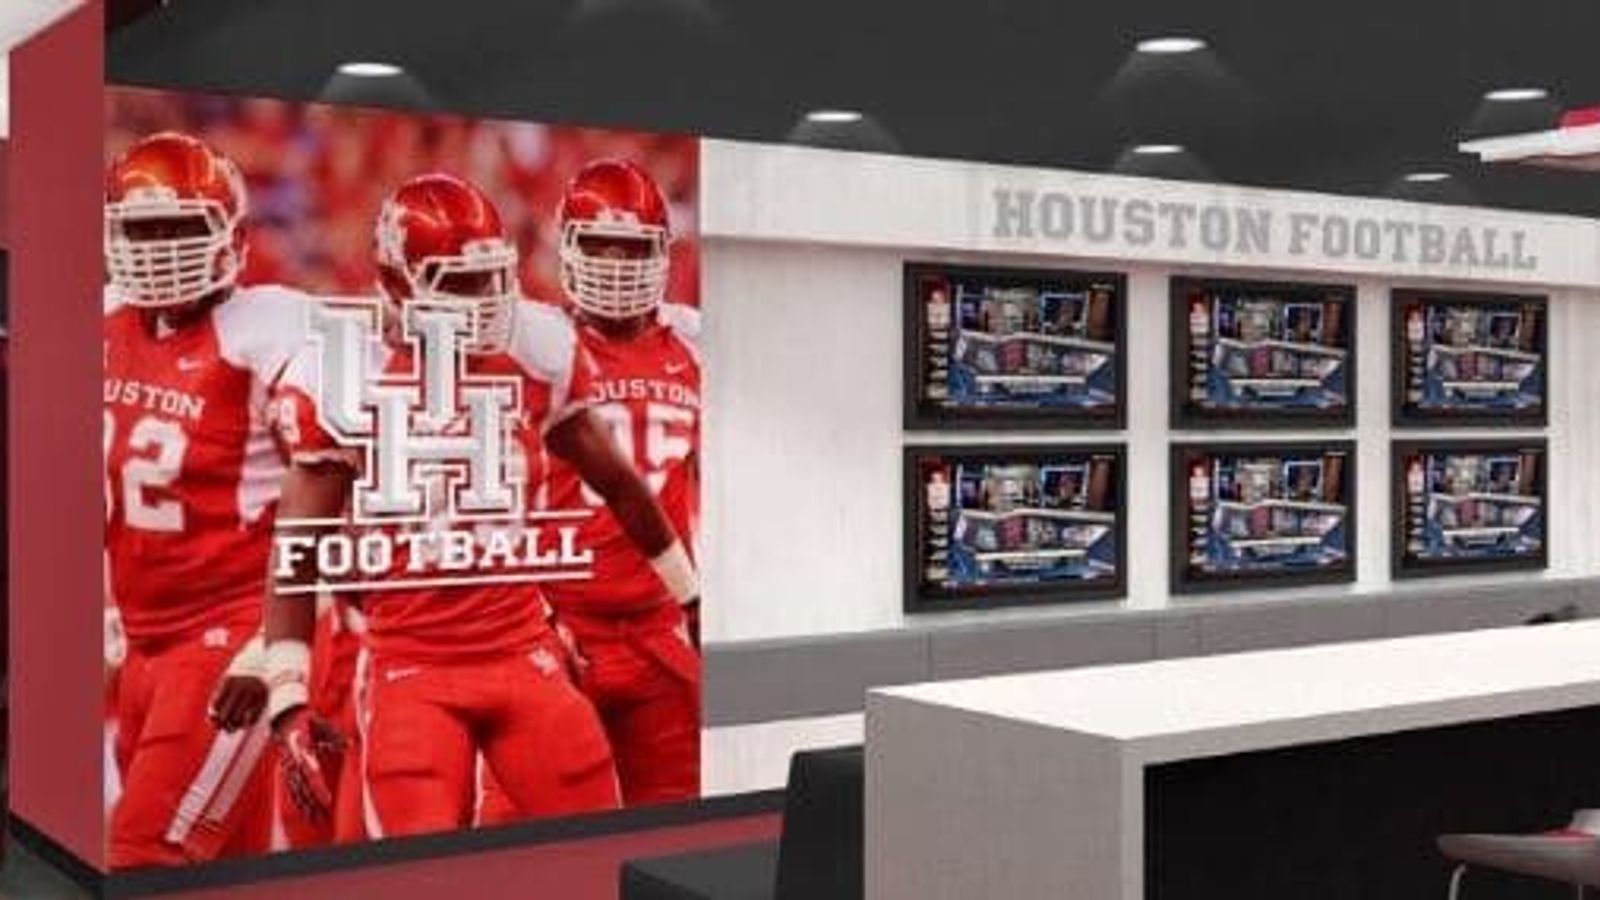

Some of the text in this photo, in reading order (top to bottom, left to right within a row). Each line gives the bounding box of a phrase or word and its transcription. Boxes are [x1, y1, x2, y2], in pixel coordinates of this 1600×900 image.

[992, 189, 1537, 271] HOUSTON FOOTBALL
[305, 297, 524, 525] UH
[273, 527, 595, 578] FOOTBALL
